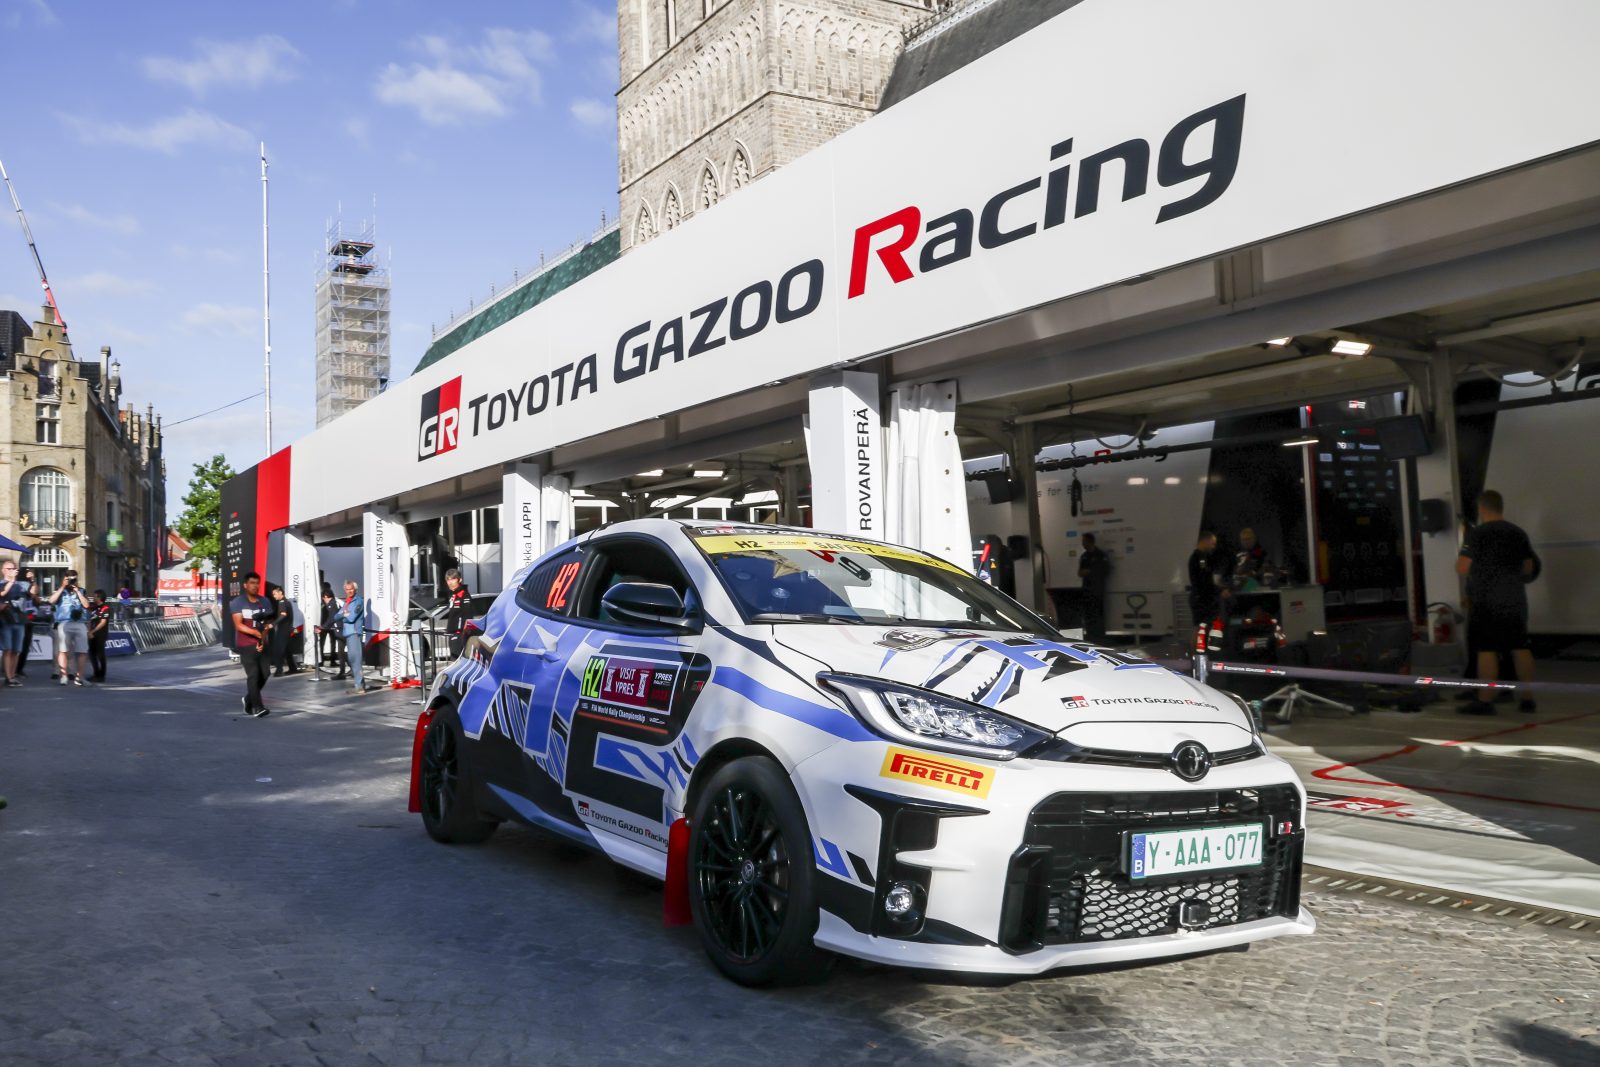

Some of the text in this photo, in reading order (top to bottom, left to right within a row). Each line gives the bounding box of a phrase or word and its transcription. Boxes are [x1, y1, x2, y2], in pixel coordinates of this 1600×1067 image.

[418, 92, 1247, 460] GR TOYOTA GAZOO Racing
[853, 407, 872, 531] ROVANPERÄ
[522, 502, 532, 538] LAPPI
[376, 518, 384, 560] KATSUTA
[734, 540, 763, 549] H2
[545, 561, 581, 609] H2
[104, 638, 130, 649] UNDAI
[581, 657, 606, 698] H2
[615, 680, 635, 696] YPRES
[620, 667, 637, 681] VISIT
[654, 672, 673, 682] YPRES
[598, 705, 609, 715] World
[608, 708, 619, 718] Rally
[618, 709, 646, 723] Championship
[1064, 700, 1089, 709] GR
[1144, 697, 1184, 705] GAZOO
[1184, 699, 1220, 711] Racing
[890, 753, 984, 791] PIRELLI
[590, 810, 617, 825] TOYOTA
[617, 820, 644, 835] GAZOO
[644, 828, 669, 848] Racing
[1134, 831, 1259, 873] B Y-AAA-077
